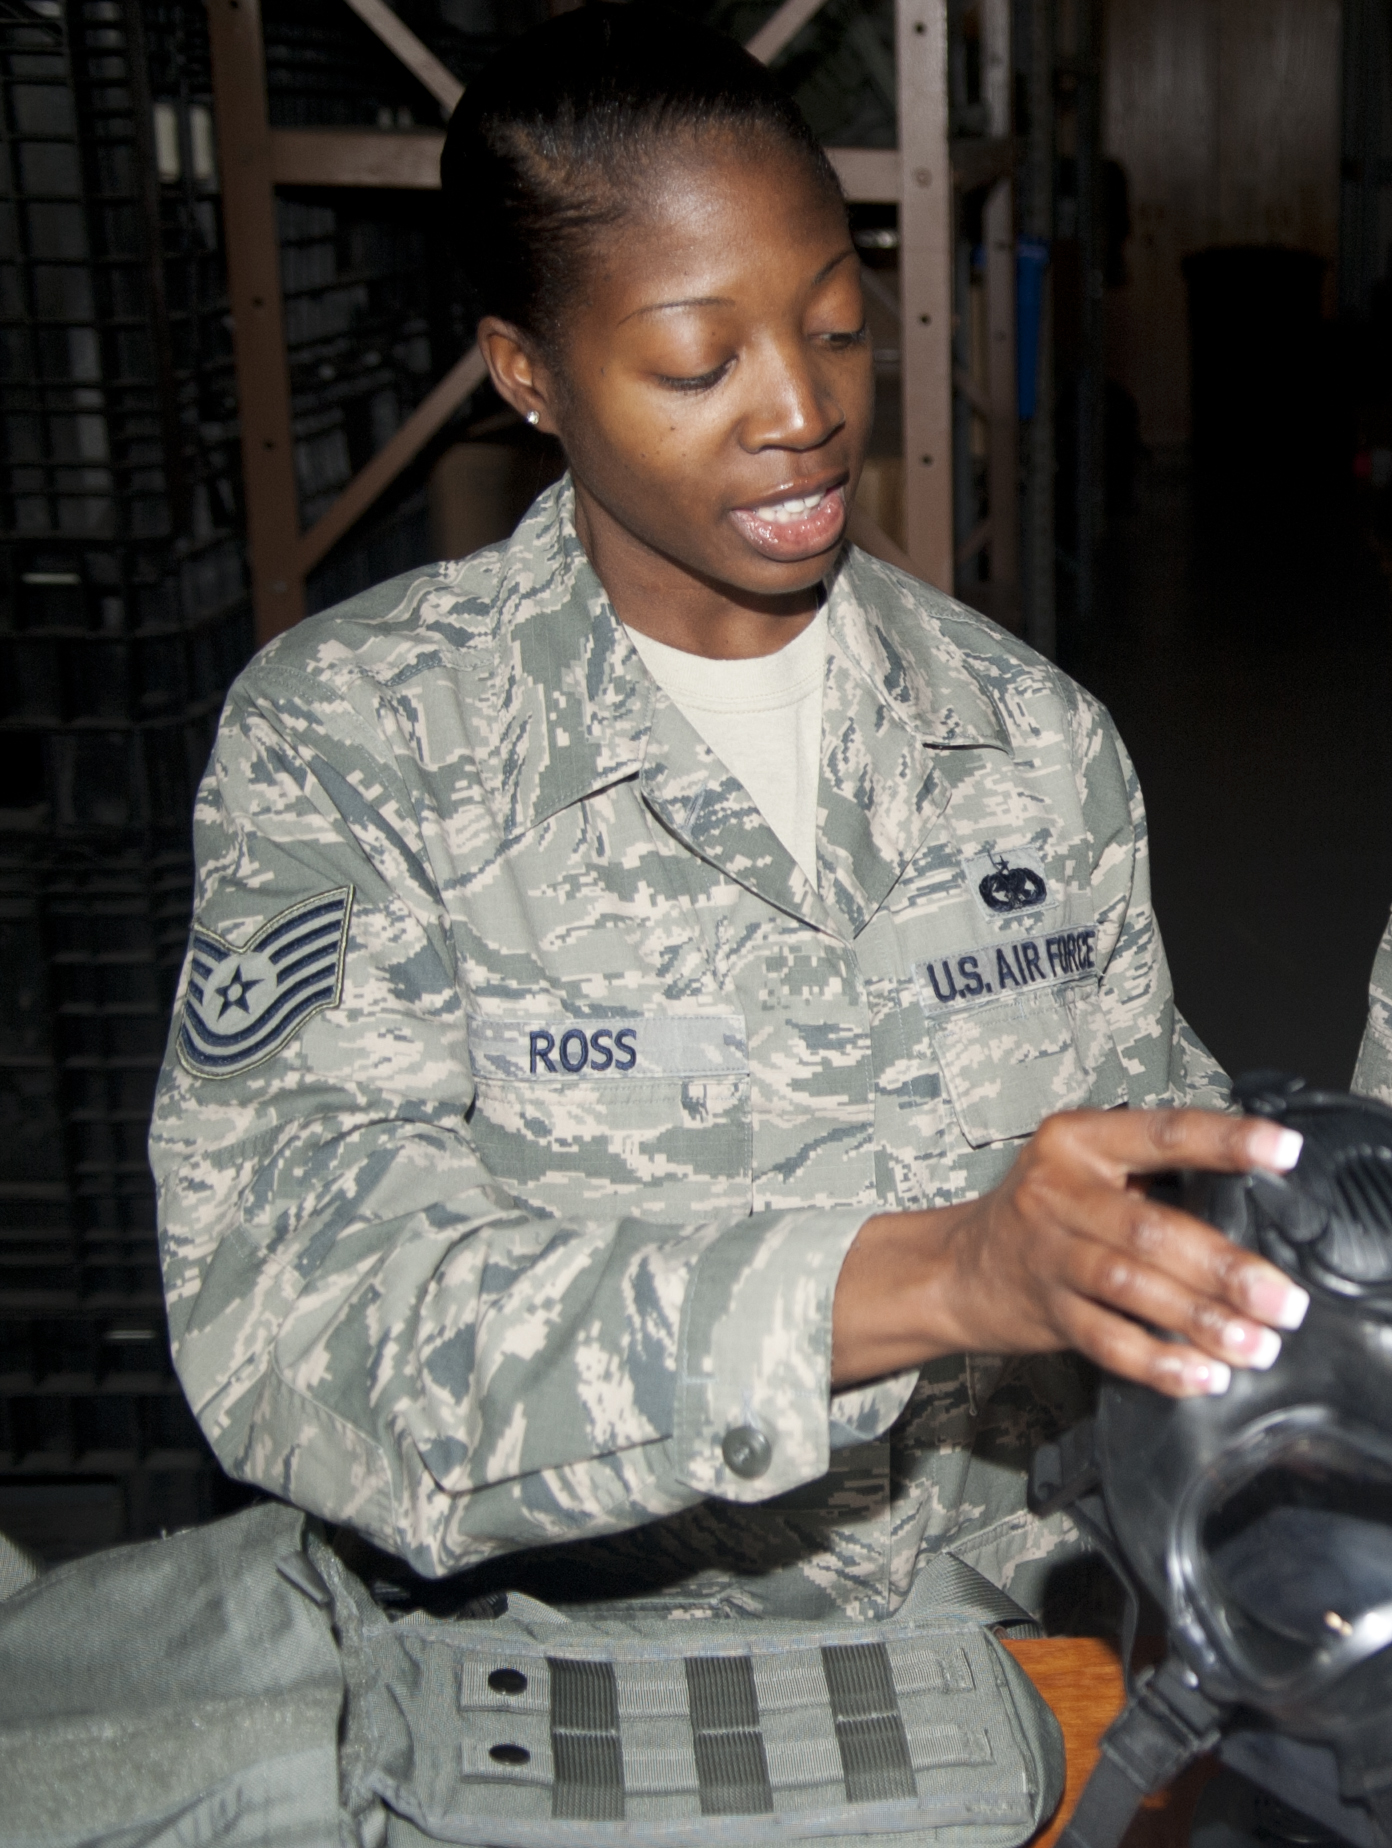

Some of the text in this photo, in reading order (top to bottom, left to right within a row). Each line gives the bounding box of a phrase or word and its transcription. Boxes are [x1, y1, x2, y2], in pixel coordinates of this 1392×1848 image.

[927, 930, 1096, 1003] U.S. AIR FORCE
[529, 1028, 637, 1074] ROSS
